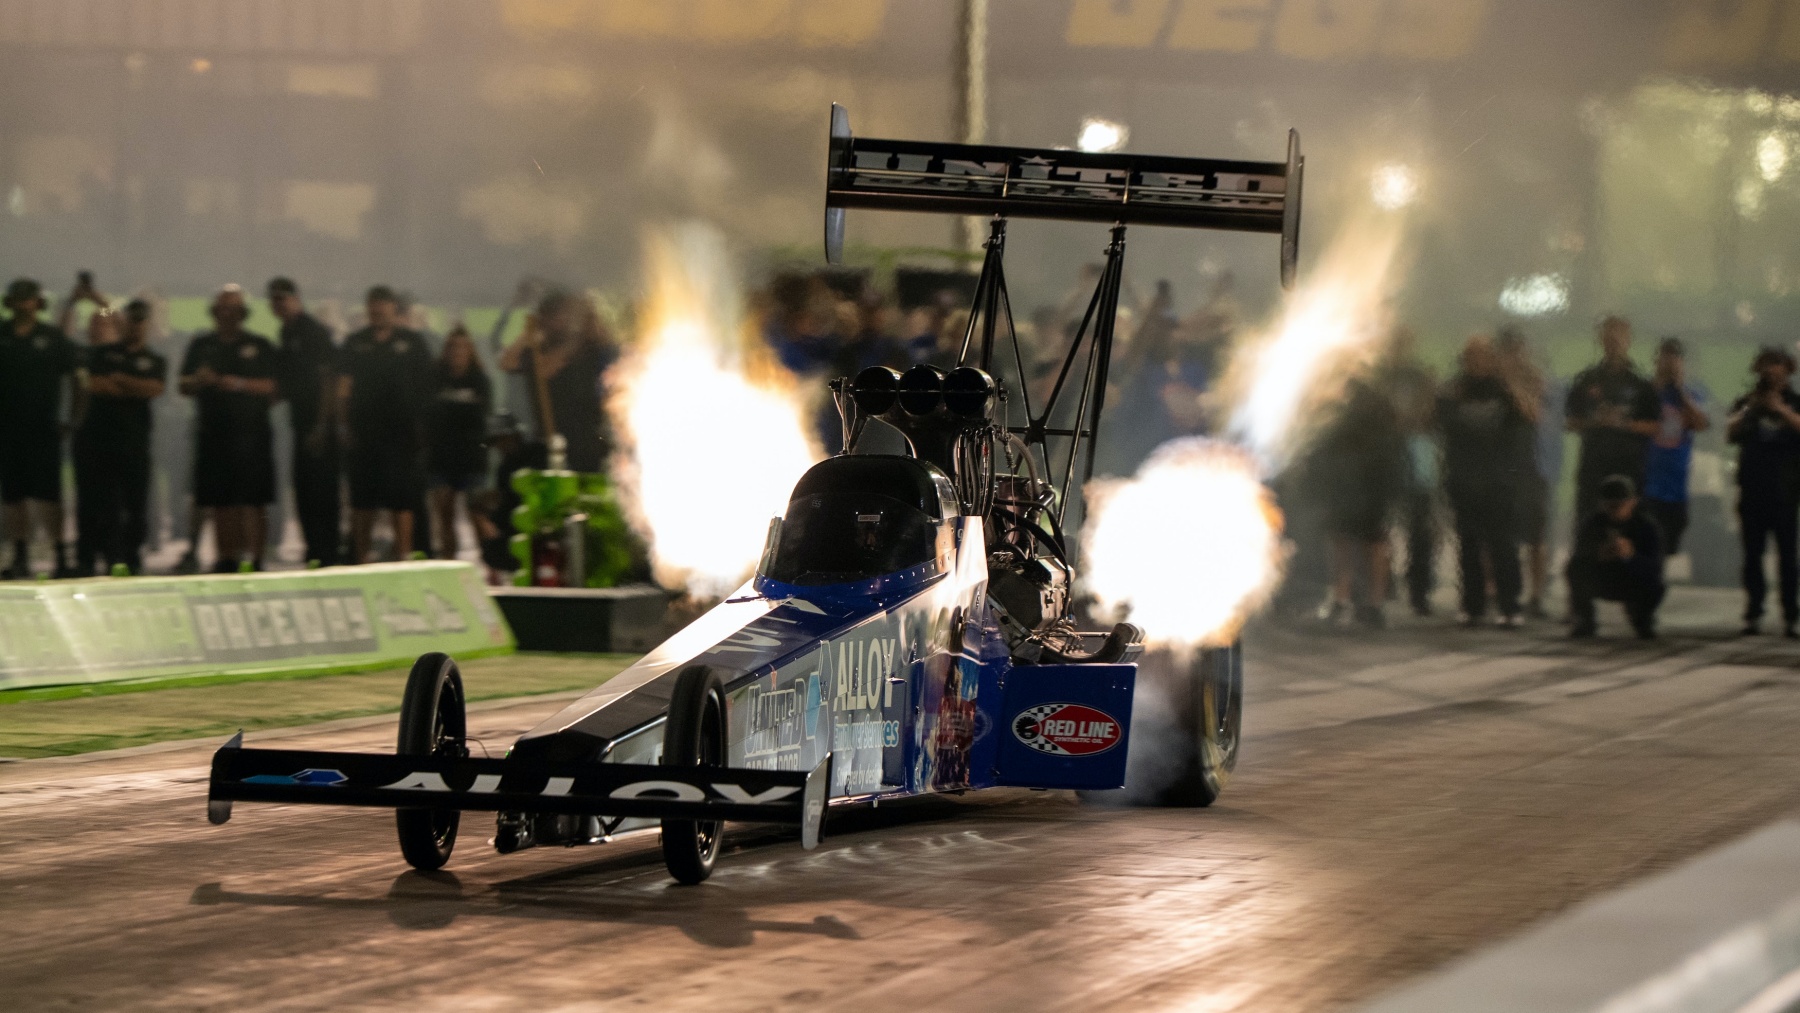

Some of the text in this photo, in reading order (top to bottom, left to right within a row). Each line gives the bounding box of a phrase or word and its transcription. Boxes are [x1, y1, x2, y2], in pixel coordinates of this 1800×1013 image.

[833, 638, 896, 712] ALLOY
[1043, 719, 1115, 738] RED LINE
